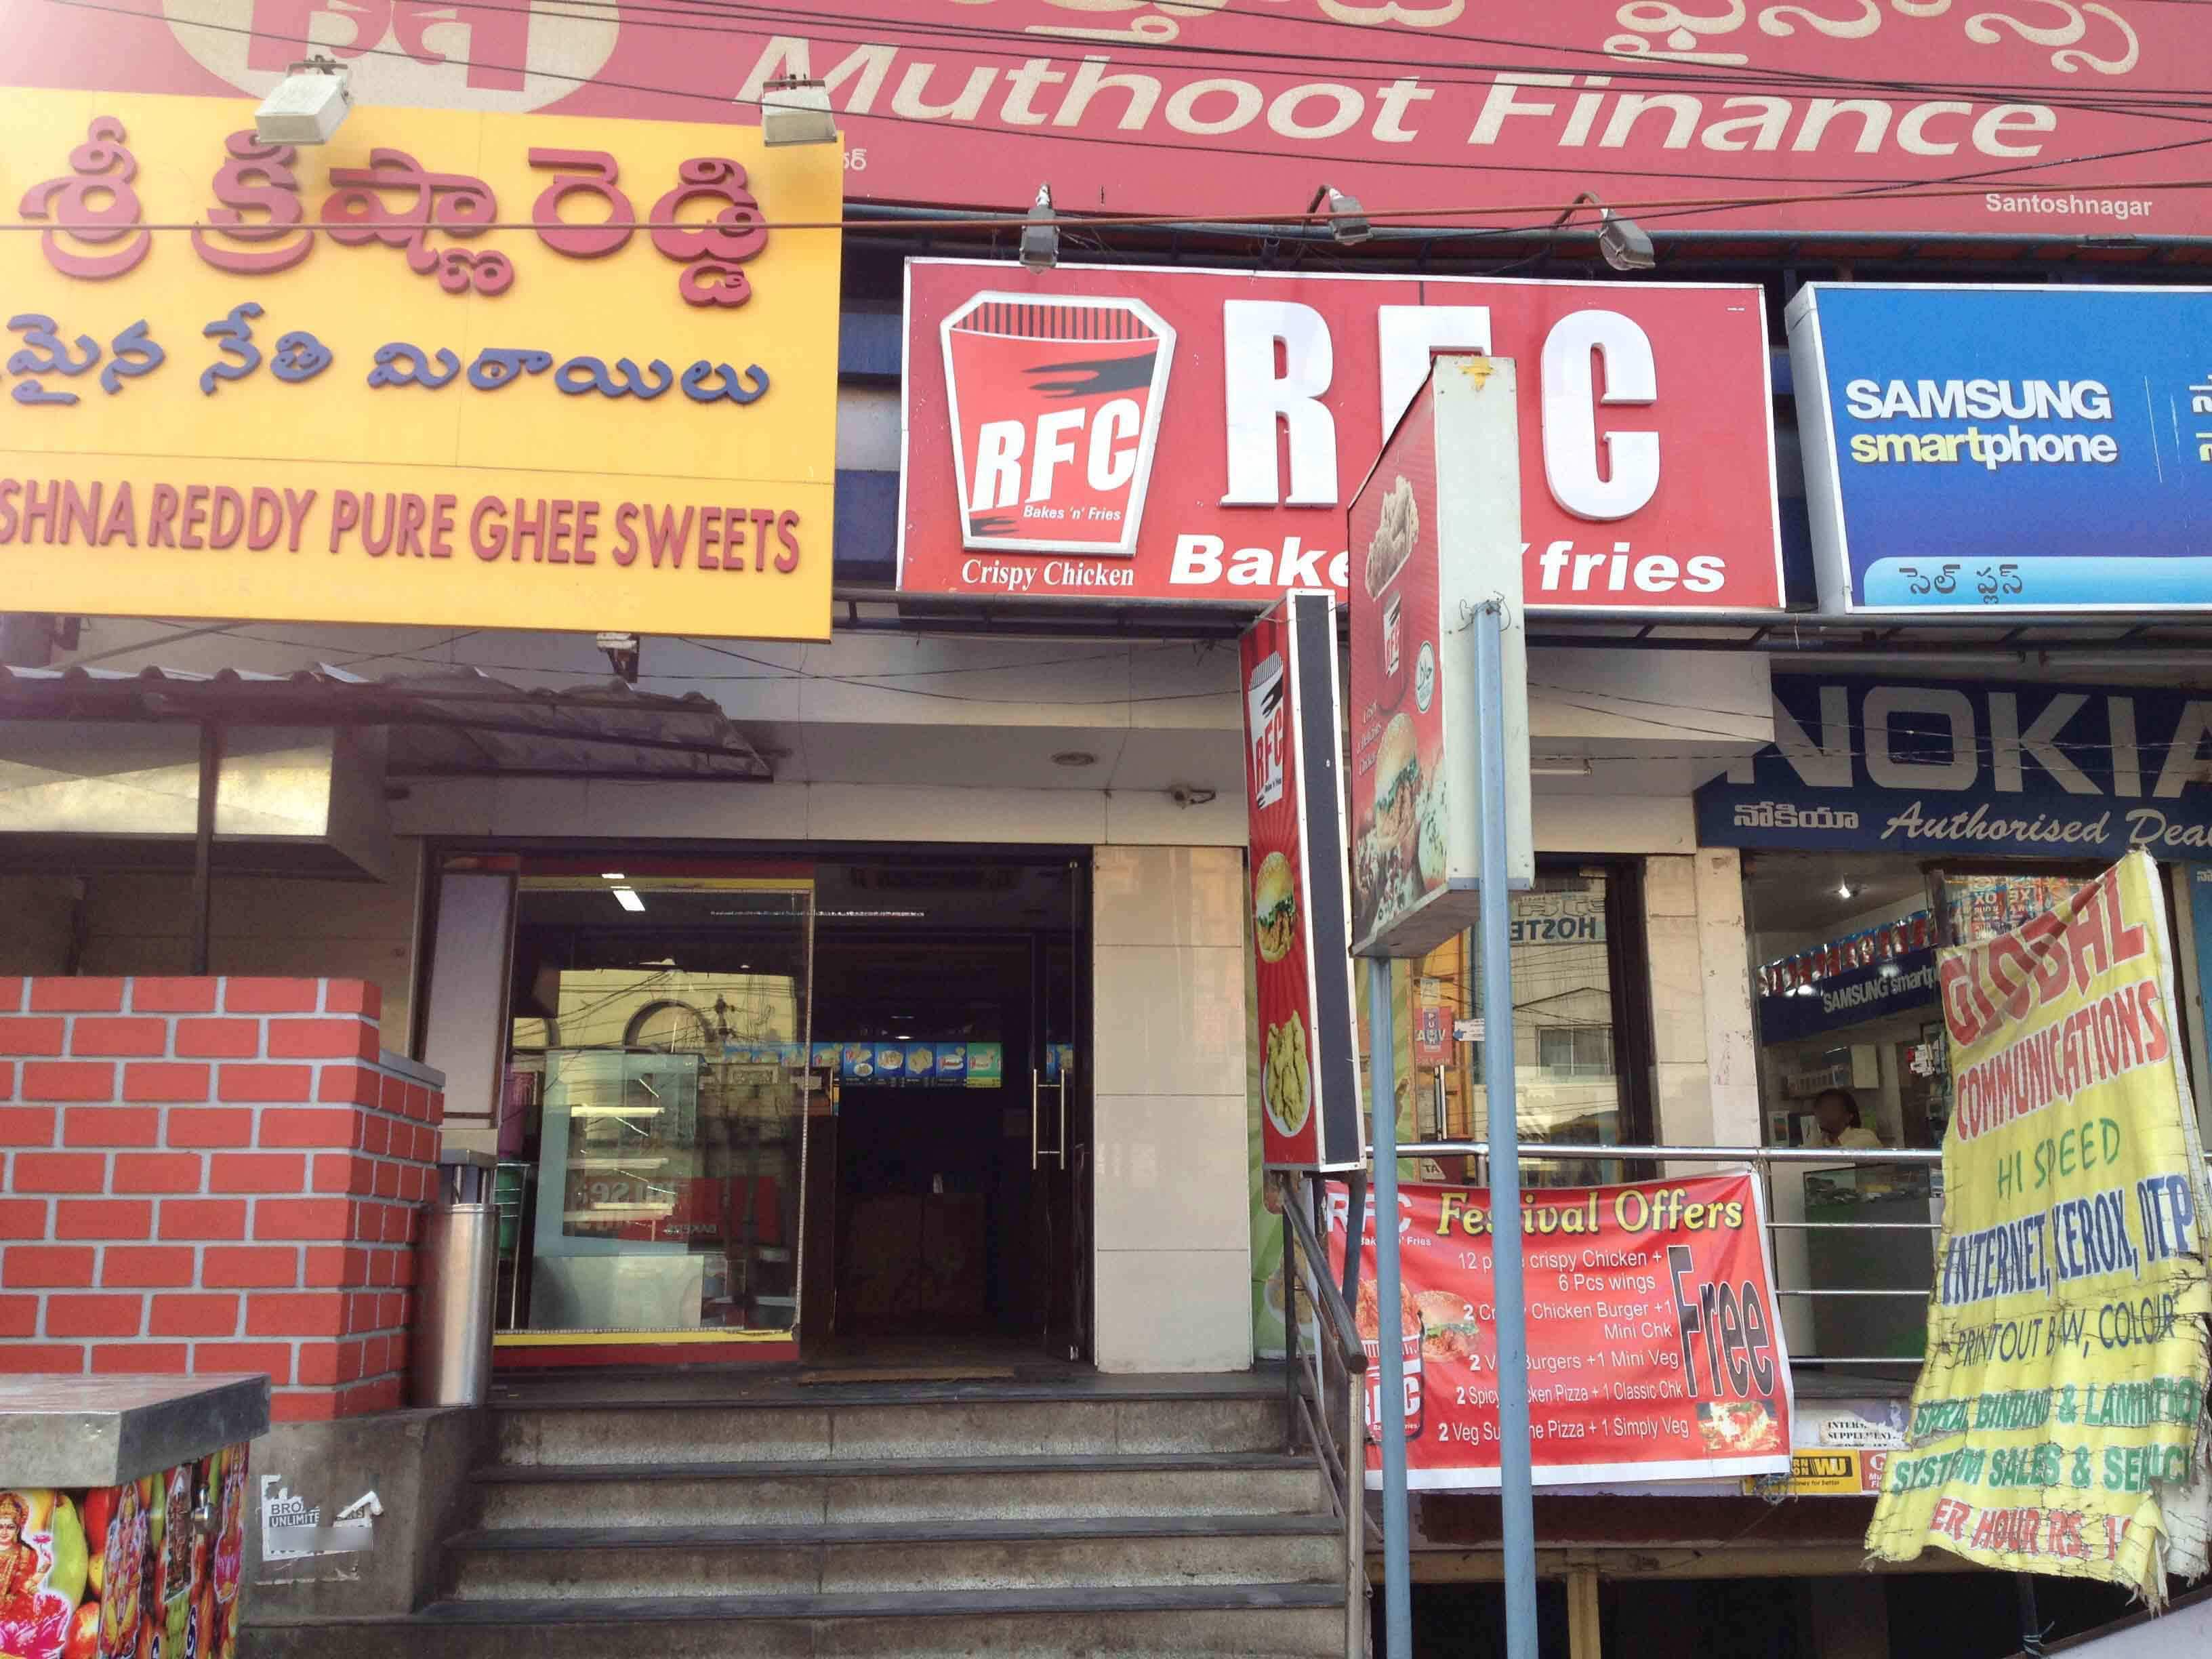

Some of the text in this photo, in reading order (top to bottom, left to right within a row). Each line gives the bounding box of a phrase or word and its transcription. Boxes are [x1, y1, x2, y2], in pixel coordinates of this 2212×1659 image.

[733, 35, 2057, 157] Muthoot Finance
[1986, 192, 2152, 220] Santoshnagar
[1846, 380, 2112, 420] SAMSUNG
[968, 398, 1141, 513] RFC
[1851, 426, 2118, 470] smartphone
[147, 483, 316, 552] REDDY
[329, 489, 458, 557] PURE
[470, 495, 600, 565] GHEE
[612, 502, 801, 573] SWEETS
[1023, 506, 1121, 520] Bakes 'n' Fries
[962, 558, 1134, 590] Crispy Chicken
[1540, 541, 1725, 592] fries
[1727, 686, 2212, 798] NOKIA
[1881, 800, 2212, 846] Authorised Dea
[1823, 976, 1888, 1013] SAMSUNG
[1956, 980, 2169, 1141] COMMUNICATIONS
[1997, 1118, 2121, 1201] HI SPEED
[1436, 1188, 1742, 1235] Fesival Offers
[1407, 1236, 1432, 1246] Fries
[1458, 1252, 1477, 1269] 12
[1530, 1251, 1577, 1272] crispy
[1582, 1249, 1647, 1268] Chicken
[1559, 1273, 1656, 1294] 6 Pcs wings
[1463, 1304, 1475, 1322] 2
[1532, 1303, 1593, 1320] Chicken
[1597, 1301, 1649, 1321] Burger
[1604, 1322, 1673, 1340] Mini Chk
[1667, 1244, 1774, 1399] Free
[1469, 1355, 1481, 1371] 2
[1611, 1351, 1644, 1367] Mini
[1648, 1349, 1679, 1370] Veg
[1456, 1386, 1466, 1405] 2
[1555, 1383, 1589, 1402] Pizza
[1603, 1383, 1610, 1399] 1
[1614, 1380, 1657, 1400] Classic
[1659, 1379, 1683, 1399] Chk
[2058, 1383, 2077, 1424] &
[1438, 1422, 1450, 1441] 2
[1452, 1421, 1479, 1446] Veg
[1548, 1419, 1585, 1438] Pizza
[1601, 1418, 1608, 1436] 1
[1613, 1418, 1659, 1439] Simply
[1662, 1416, 1689, 1438] Veg
[2071, 1445, 2090, 1488] &
